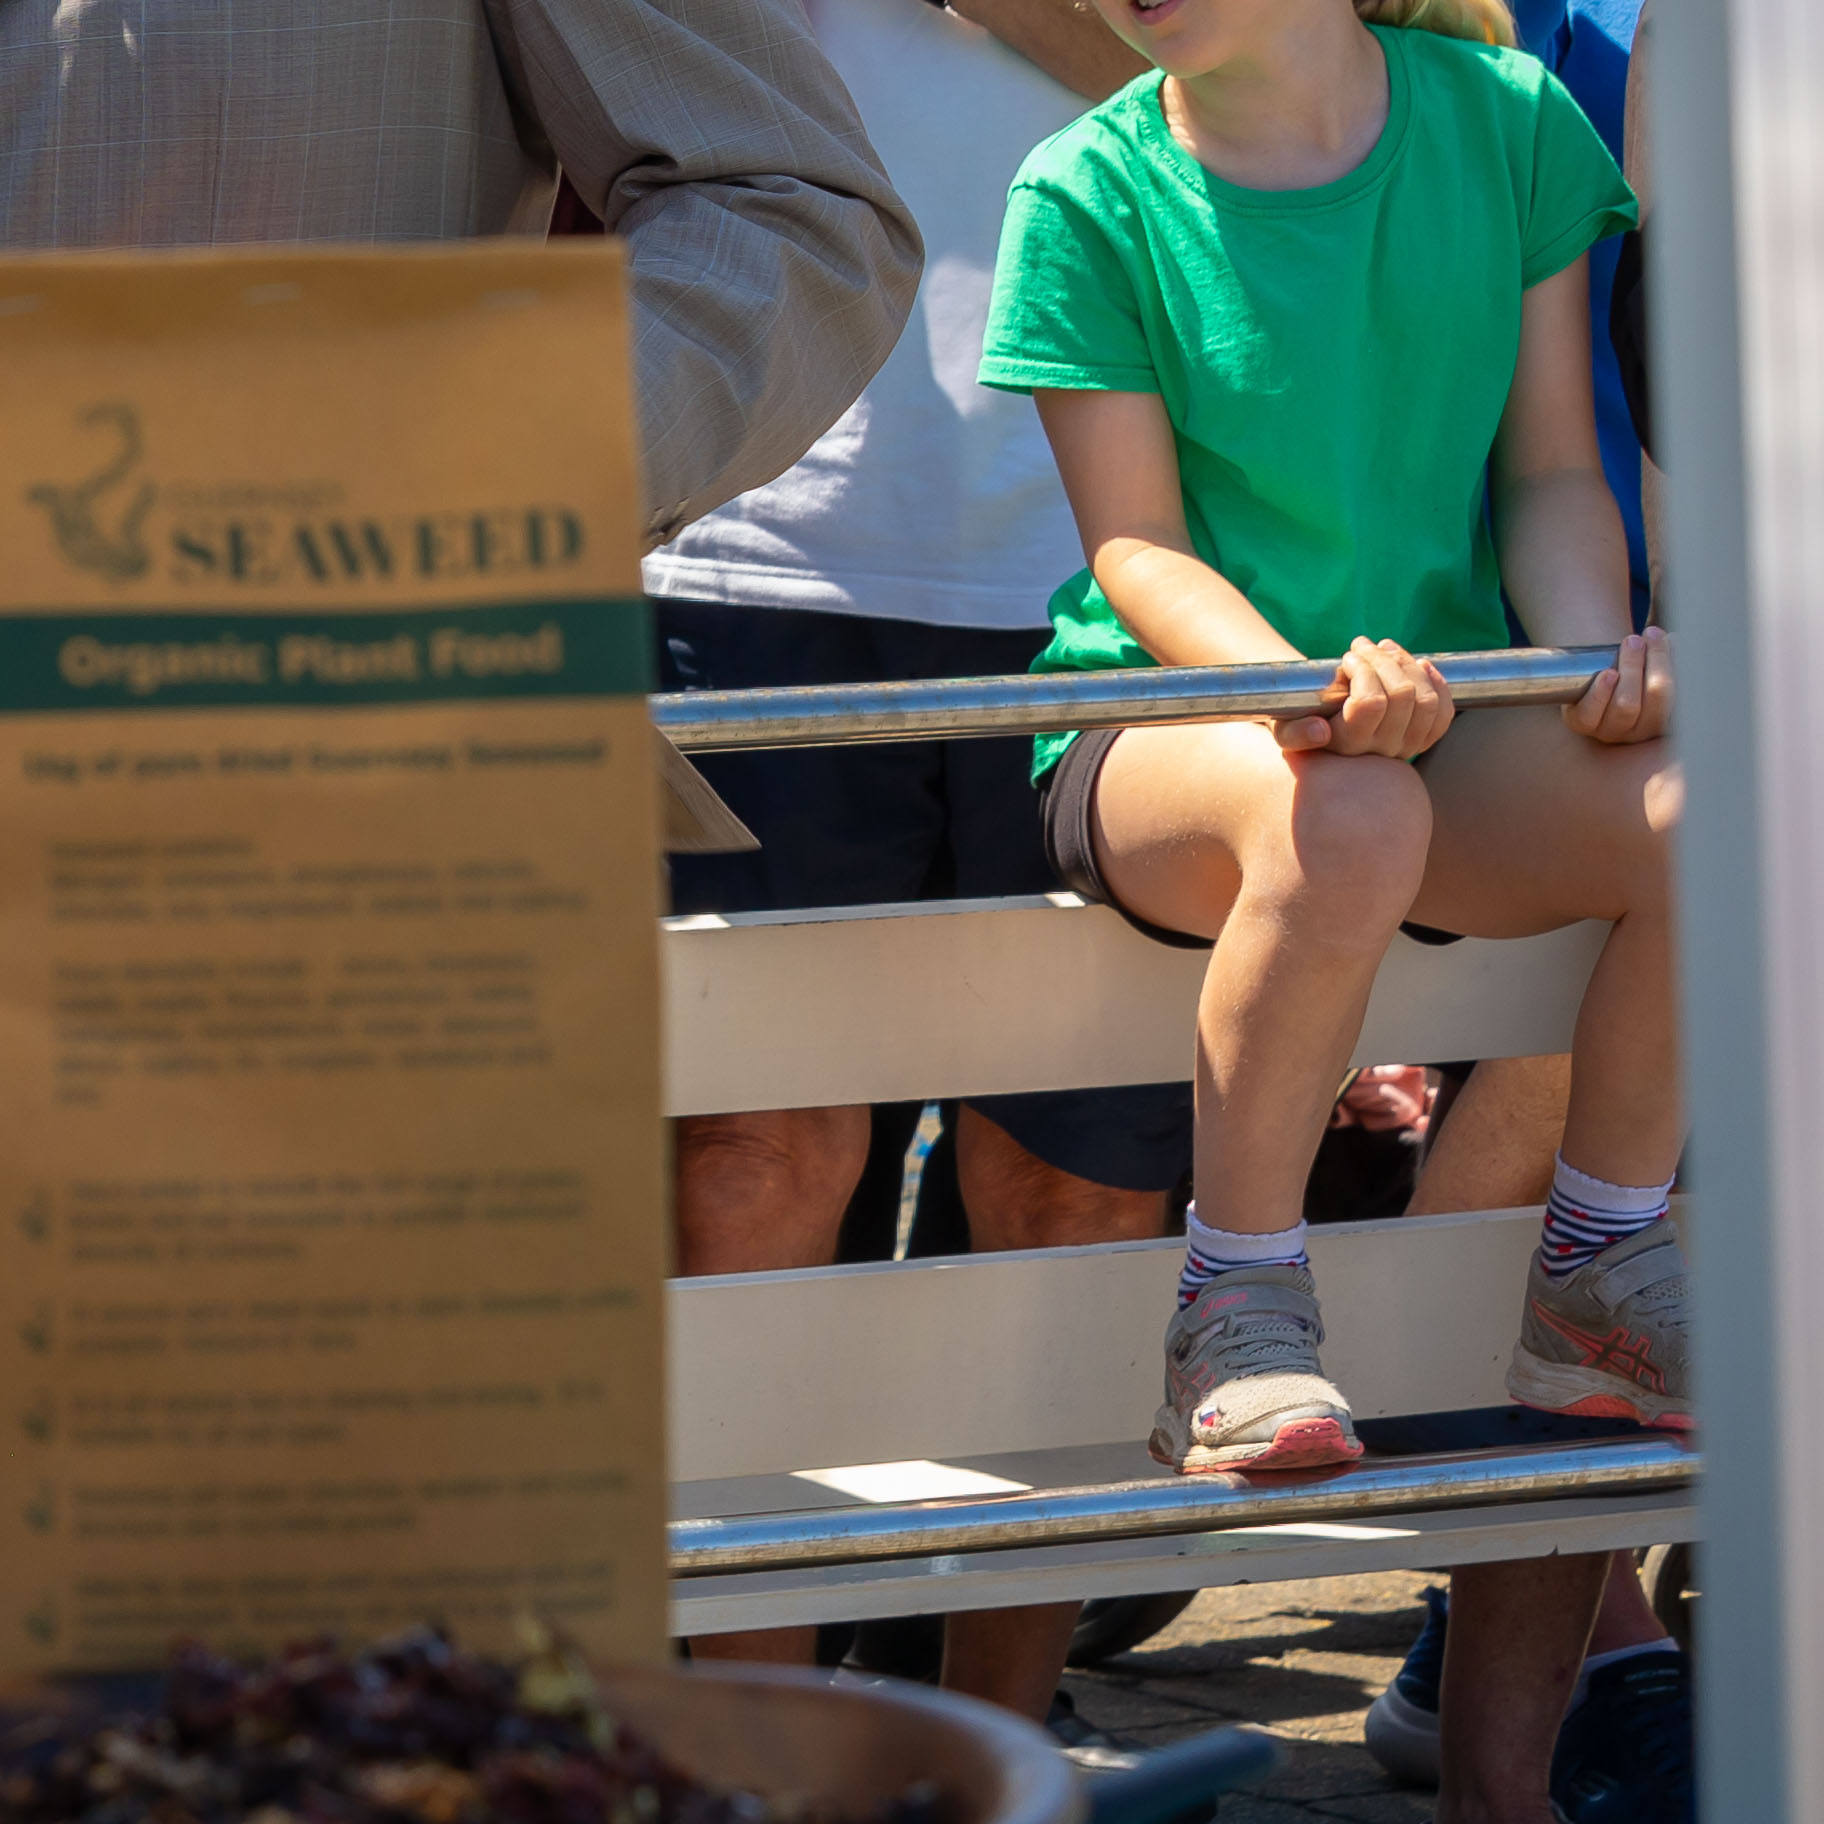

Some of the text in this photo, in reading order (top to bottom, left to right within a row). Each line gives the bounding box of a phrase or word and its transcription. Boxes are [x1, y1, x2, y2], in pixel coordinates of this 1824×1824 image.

[170, 504, 586, 586] SEAWEED
[58, 622, 564, 695] Organic Plant Food
